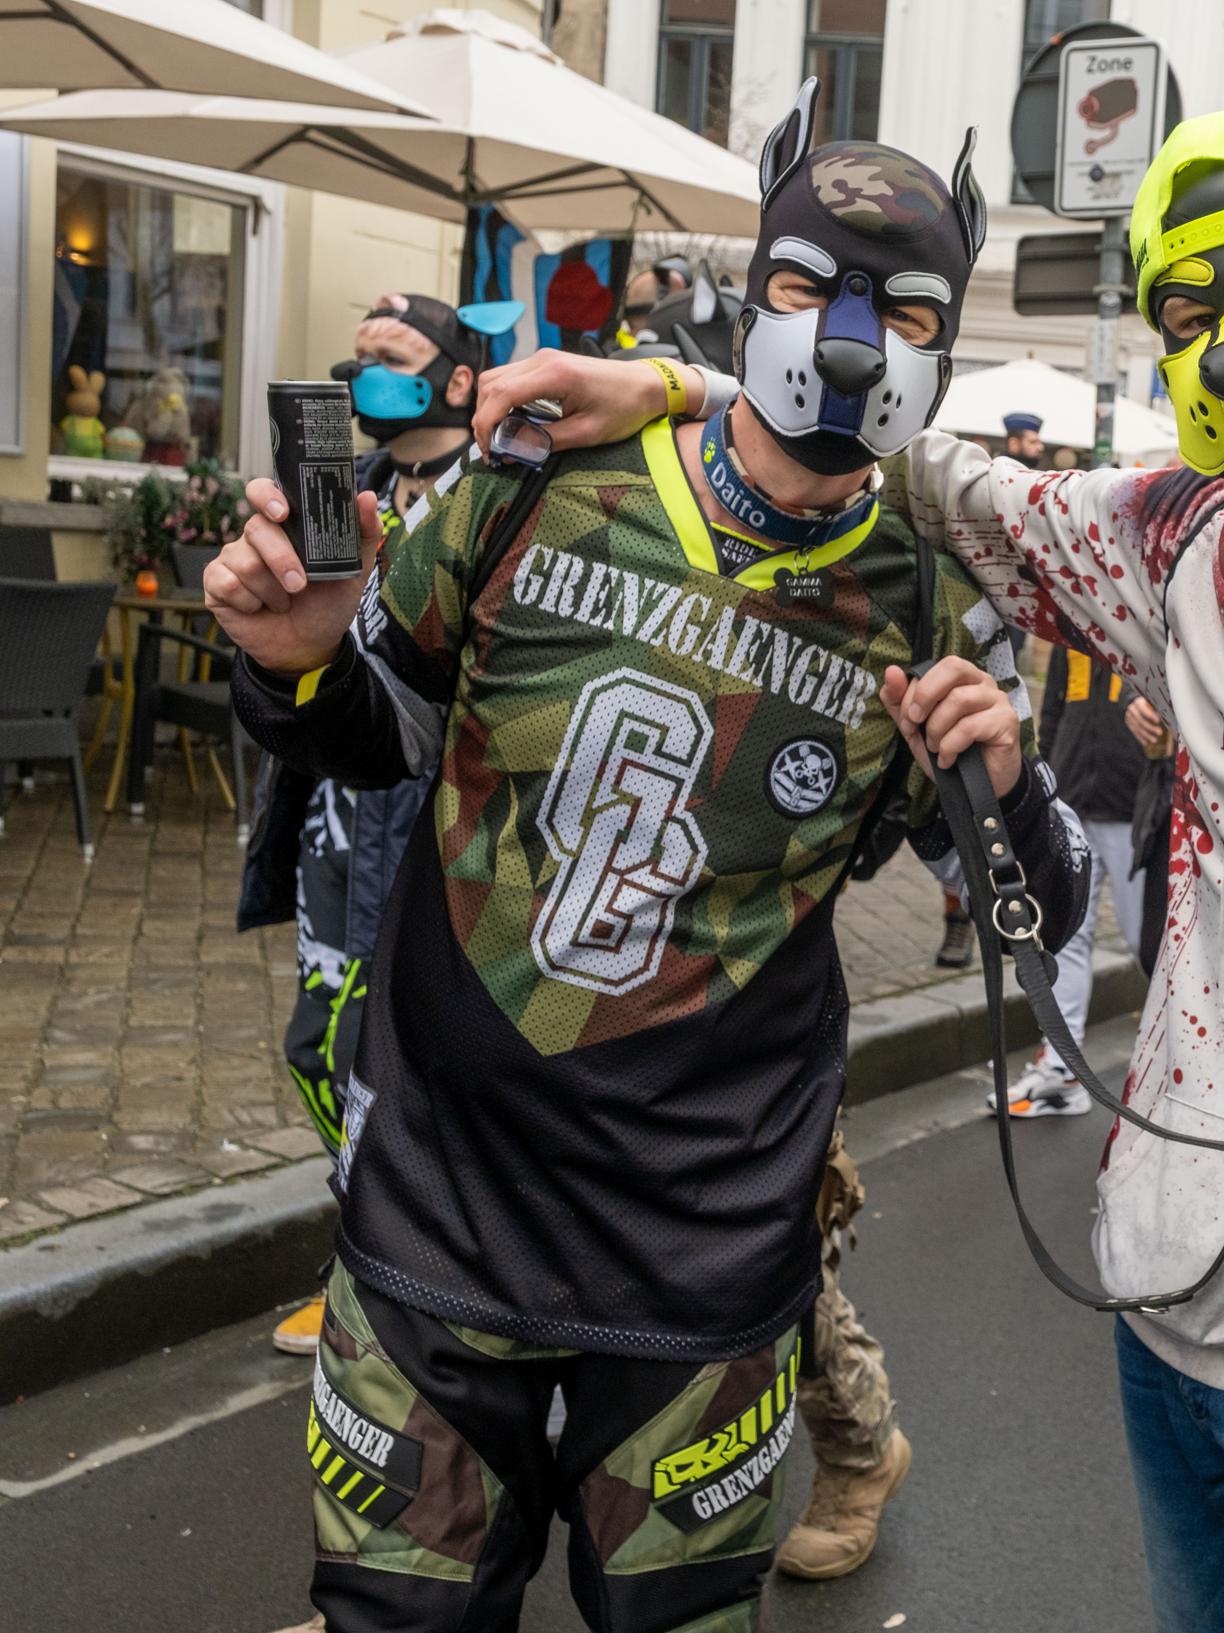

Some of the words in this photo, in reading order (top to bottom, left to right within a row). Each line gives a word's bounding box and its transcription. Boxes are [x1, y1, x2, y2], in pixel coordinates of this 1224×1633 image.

[1086, 55, 1134, 73] Zone
[710, 462, 767, 529] Daito
[785, 576, 823, 588] GAMMA
[788, 587, 821, 598] DAITO
[512, 542, 877, 730] GRENZGAENGER
